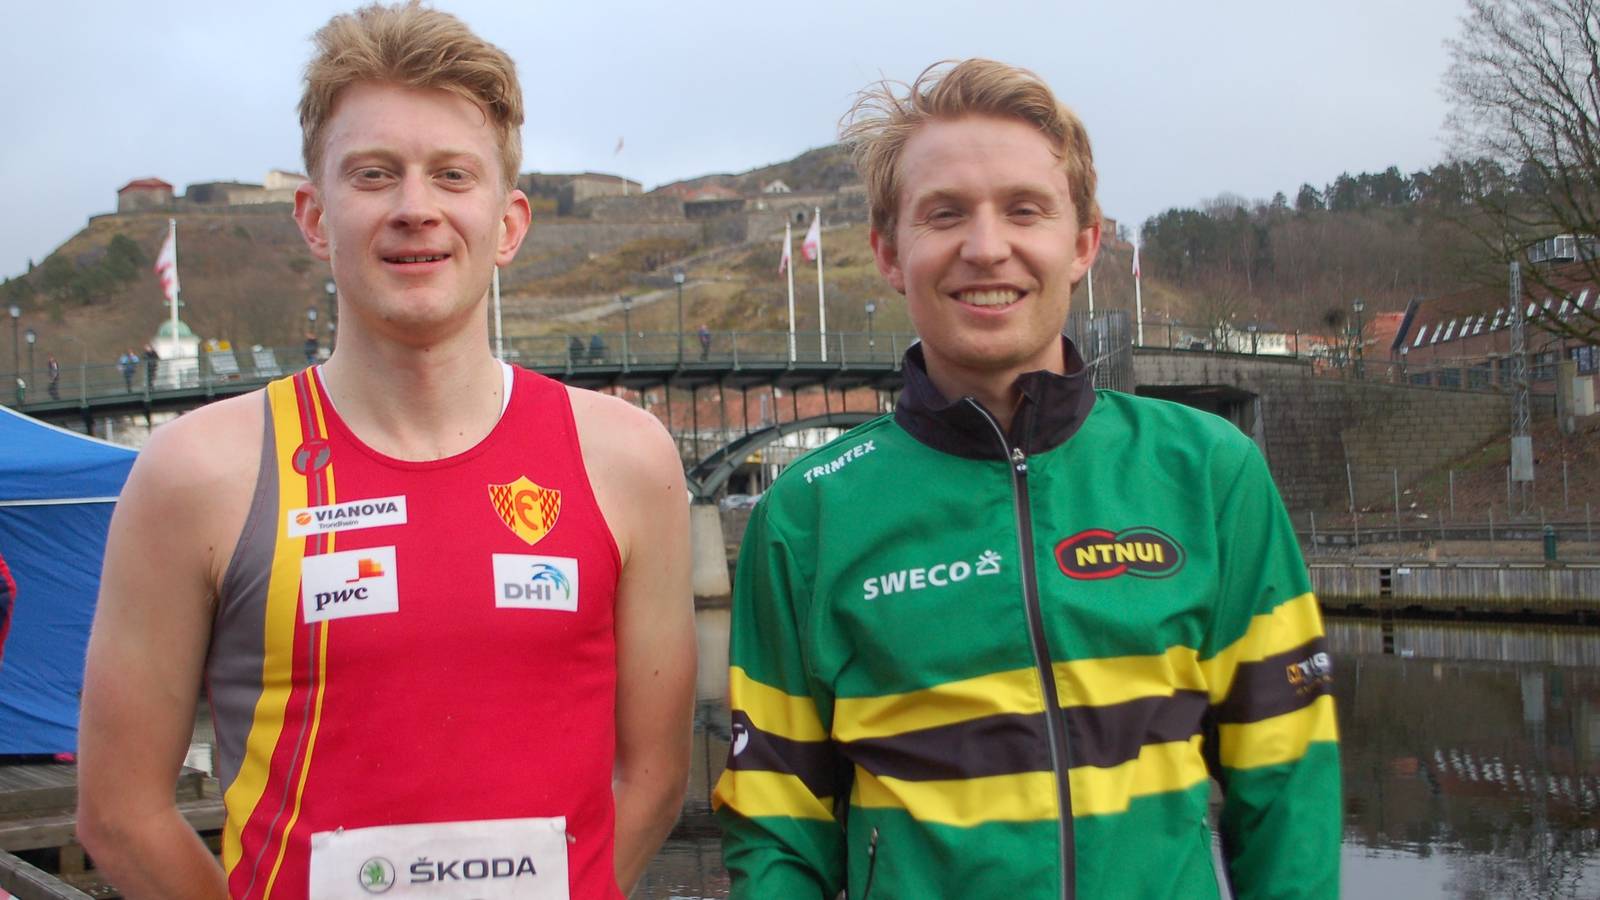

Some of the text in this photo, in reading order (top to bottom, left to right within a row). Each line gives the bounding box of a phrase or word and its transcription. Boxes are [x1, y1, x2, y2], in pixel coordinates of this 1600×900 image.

[803, 440, 877, 484] TRIMTEX
[315, 502, 398, 522] VIANOVA
[1075, 542, 1164, 567] NTNUI
[504, 583, 552, 601] DHI
[863, 561, 971, 600] SWECO
[315, 587, 368, 612] pwc
[410, 856, 537, 884] ŠKODA
